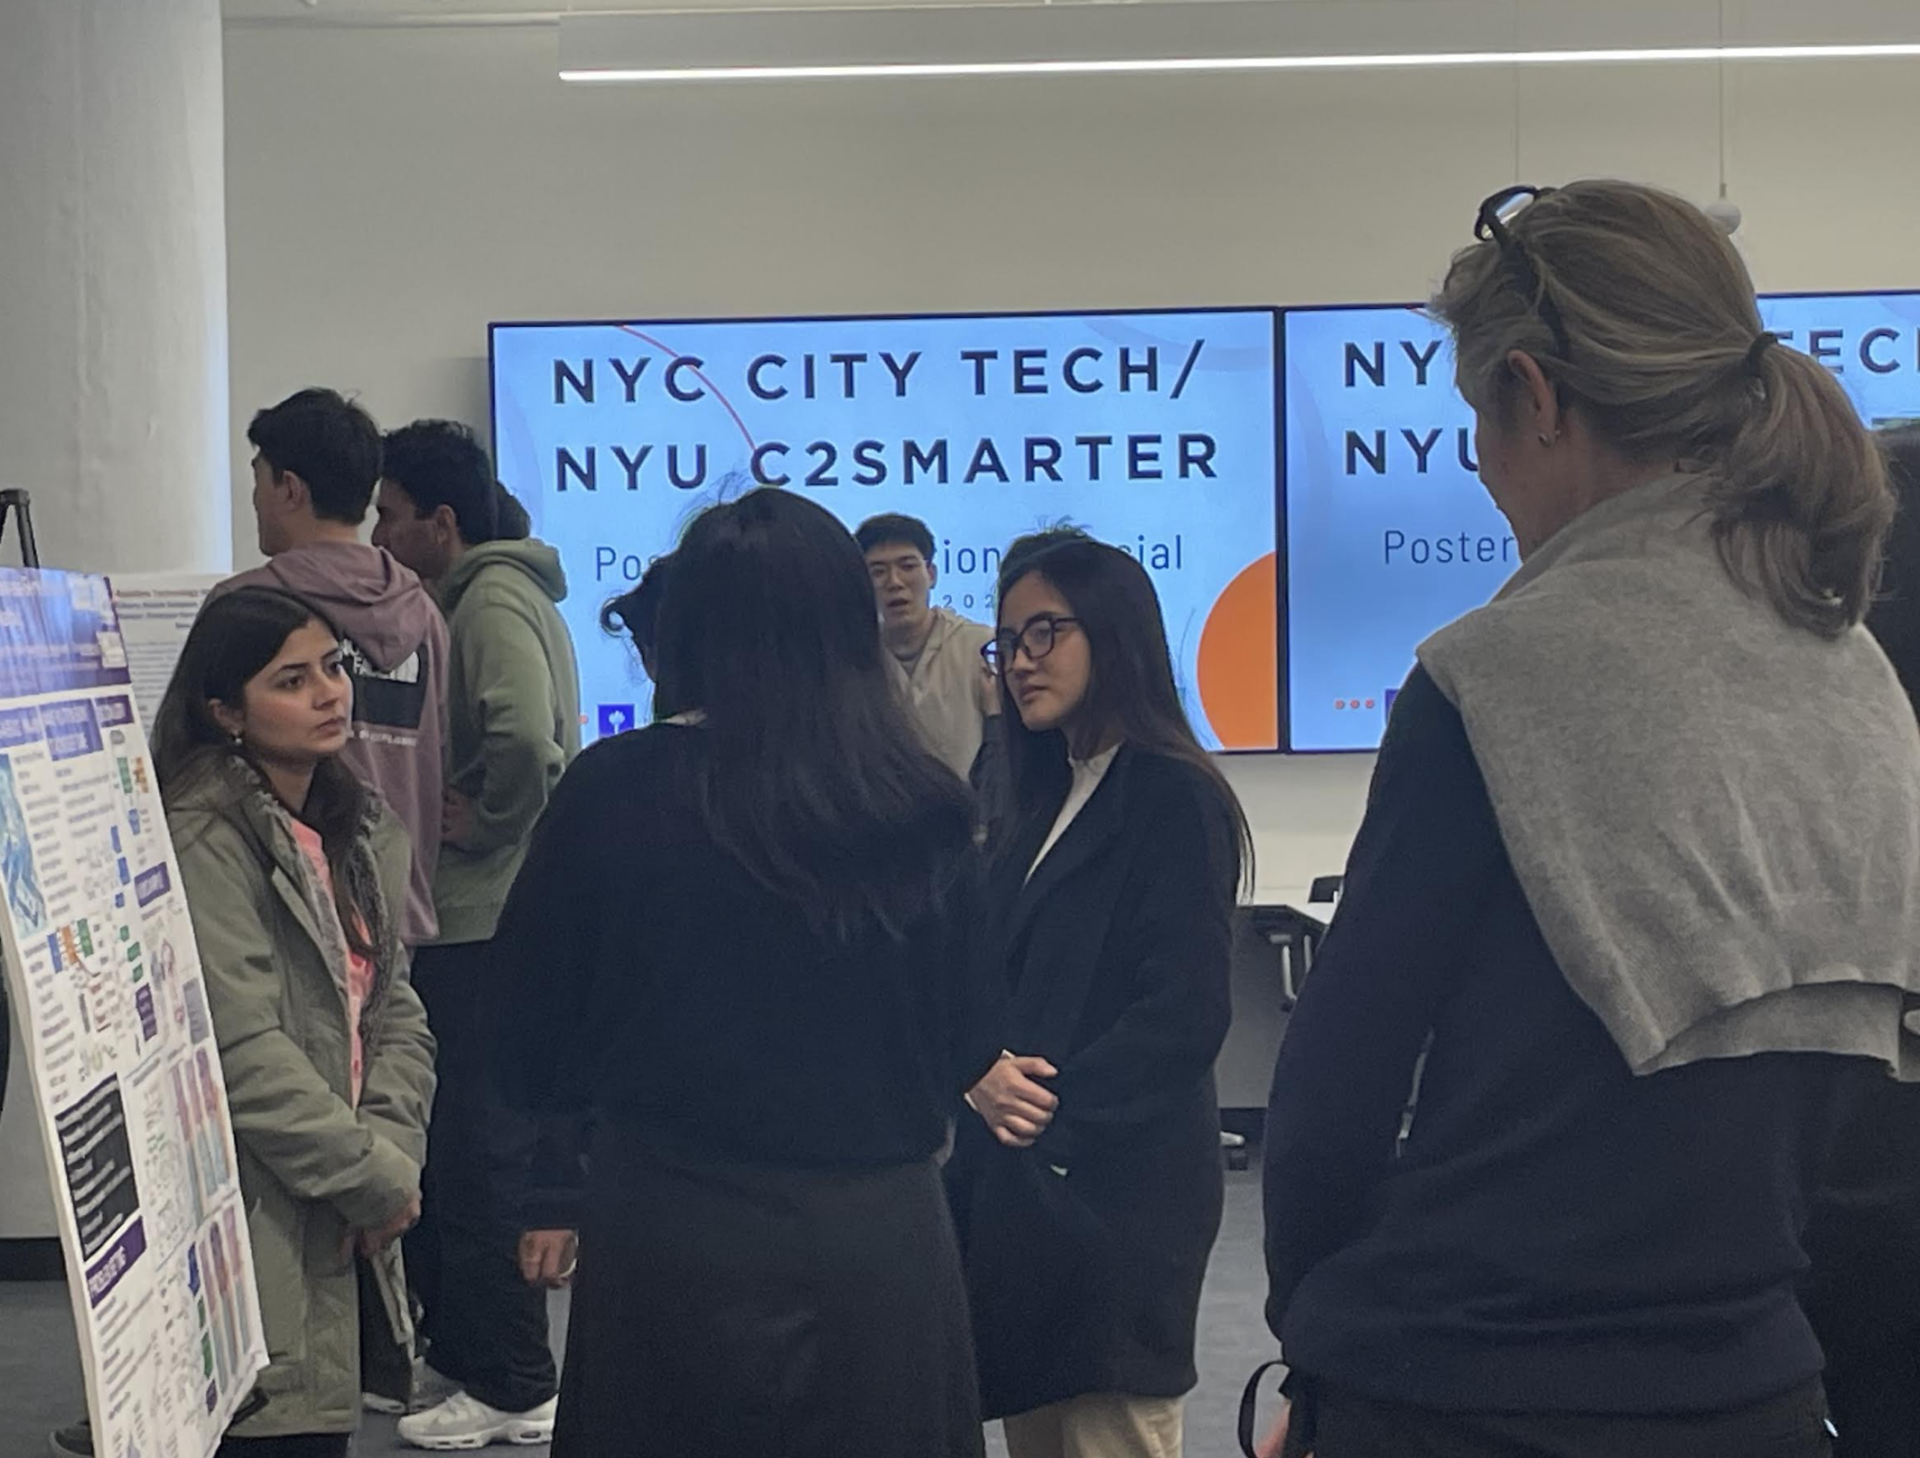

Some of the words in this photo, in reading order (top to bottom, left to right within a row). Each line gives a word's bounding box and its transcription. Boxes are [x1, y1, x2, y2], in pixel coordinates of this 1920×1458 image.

[554, 357, 706, 404] NYC
[748, 352, 922, 400] CITY
[961, 339, 1205, 399] TECH/
[1346, 341, 1443, 387] NY
[1777, 328, 1920, 374] EC
[556, 445, 707, 491] NYU
[751, 434, 1217, 487] C2SMARTER
[596, 547, 660, 581] Po
[1385, 530, 1514, 565] Poster
[943, 594, 996, 609] 202
